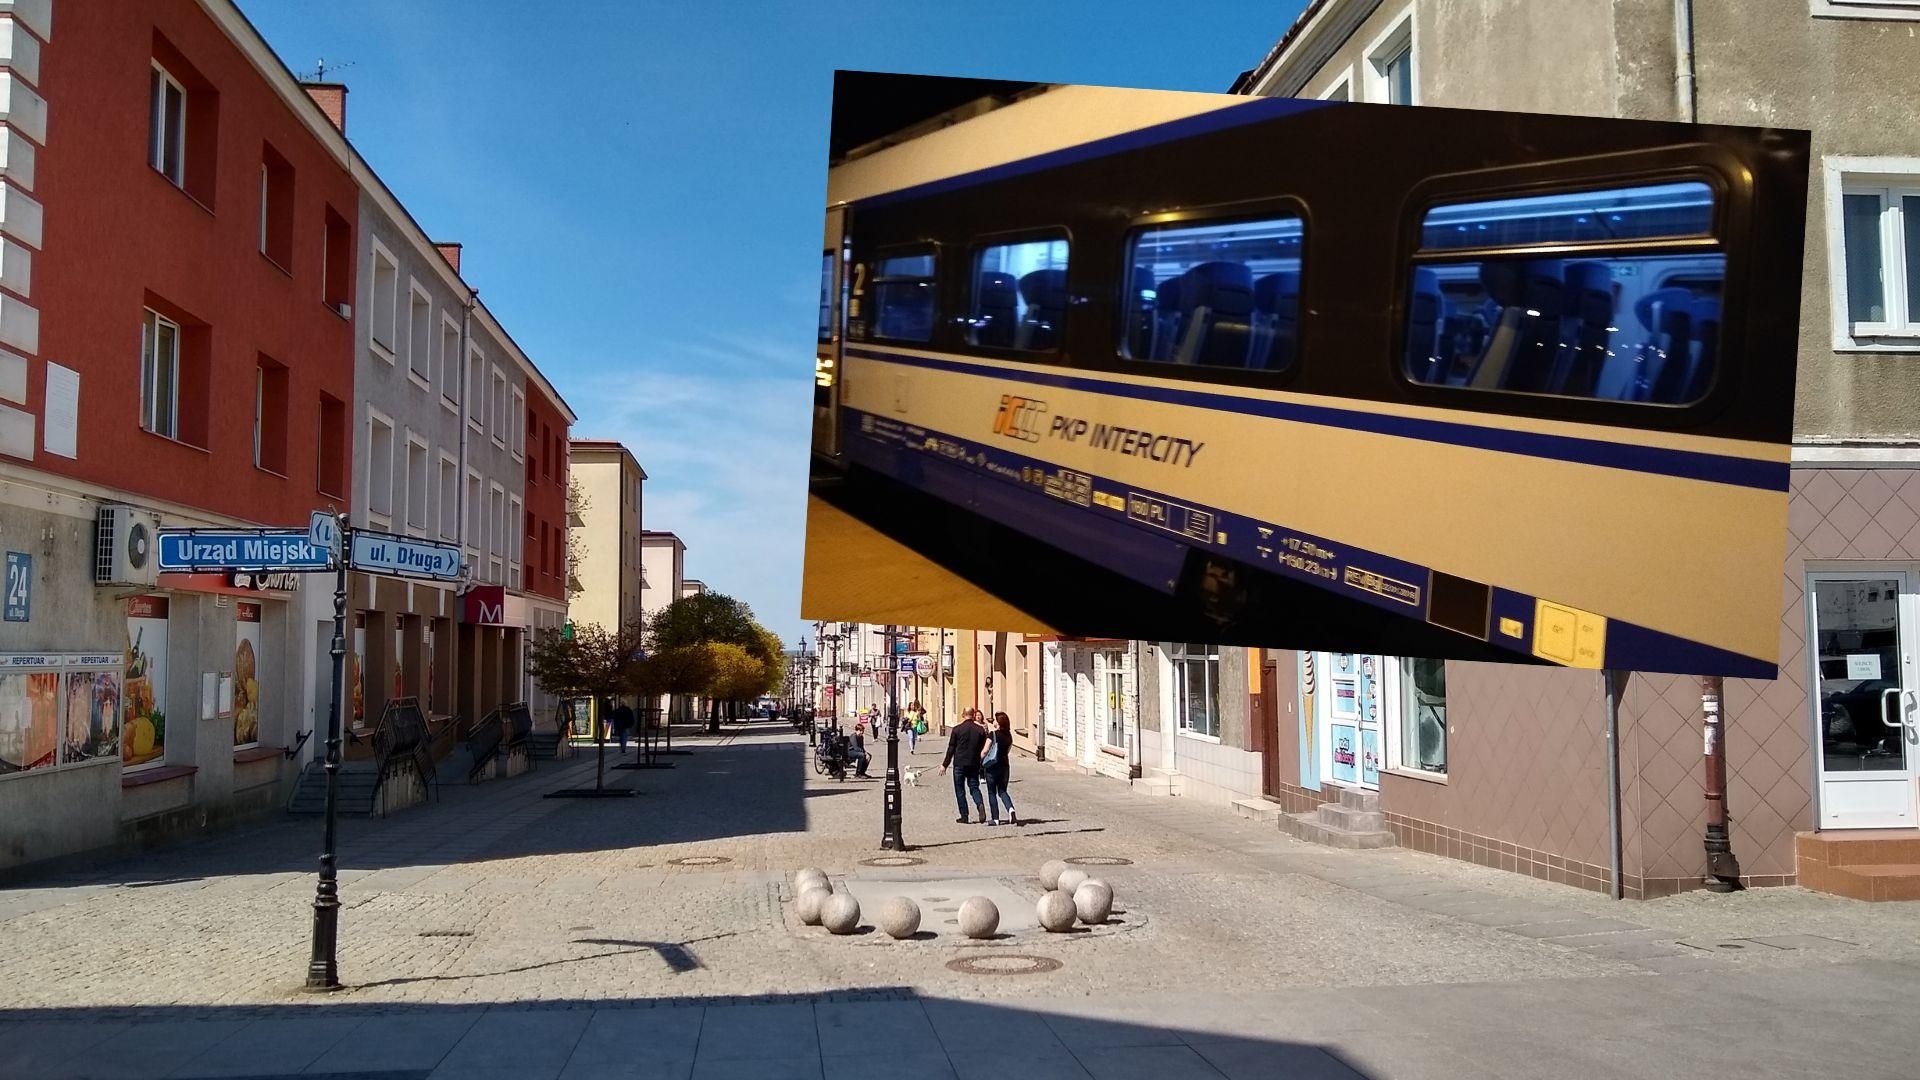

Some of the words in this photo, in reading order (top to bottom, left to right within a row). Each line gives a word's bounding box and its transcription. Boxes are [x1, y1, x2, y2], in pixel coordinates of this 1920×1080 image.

[853, 262, 866, 296] 2
[1048, 415, 1089, 442] PKP
[1089, 423, 1205, 468] INTERCITY
[178, 539, 237, 564] Urząd
[244, 540, 316, 564] Miejski
[370, 544, 391, 563] ul.
[397, 547, 442, 571] Długa
[9, 564, 27, 606] 24
[478, 600, 503, 624] M
[12, 656, 45, 665] REPERTUAR
[81, 656, 109, 664] REPERTUAR
